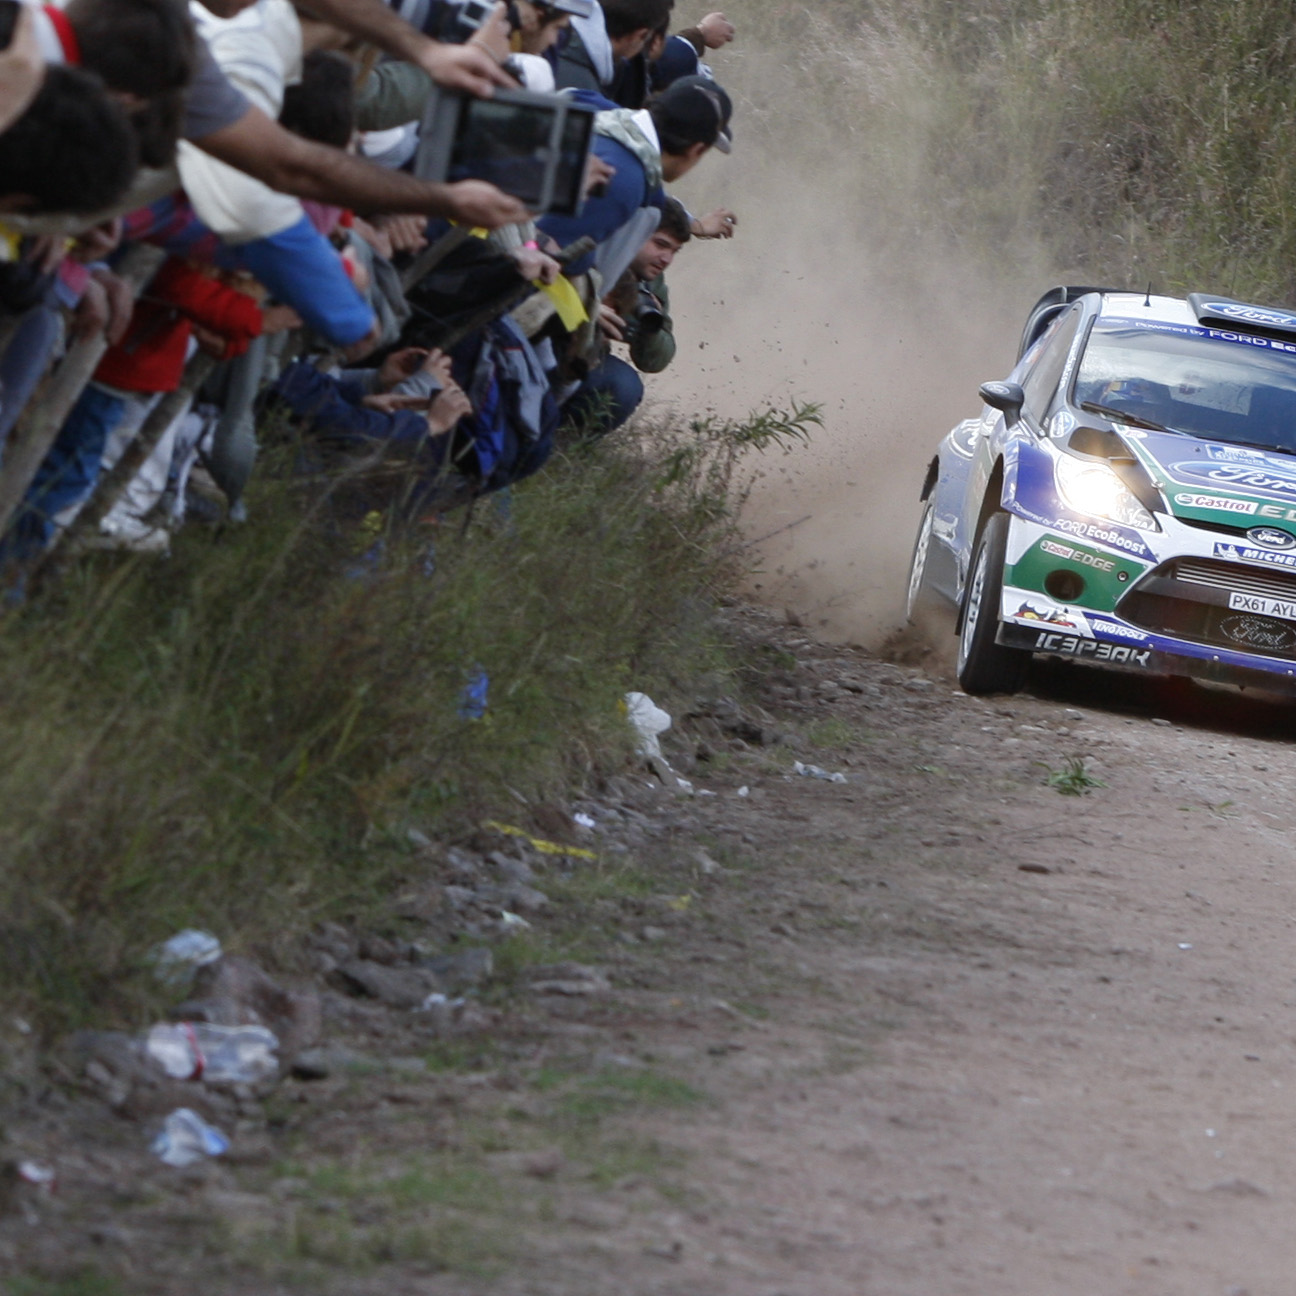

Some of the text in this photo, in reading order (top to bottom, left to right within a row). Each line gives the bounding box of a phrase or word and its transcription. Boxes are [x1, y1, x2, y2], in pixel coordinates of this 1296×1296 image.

[1223, 304, 1292, 325] Ford
[1135, 321, 1188, 334] Powered
[1190, 328, 1206, 338] by
[1209, 330, 1267, 346] FORD
[1194, 495, 1252, 513] Castrol
[1012, 501, 1044, 523] Powered
[1054, 518, 1087, 537] FORD
[1087, 526, 1147, 555] EcoBoost
[1257, 529, 1286, 545] Ford
[1072, 551, 1115, 573] EDGE
[1233, 595, 1266, 612] PX61
